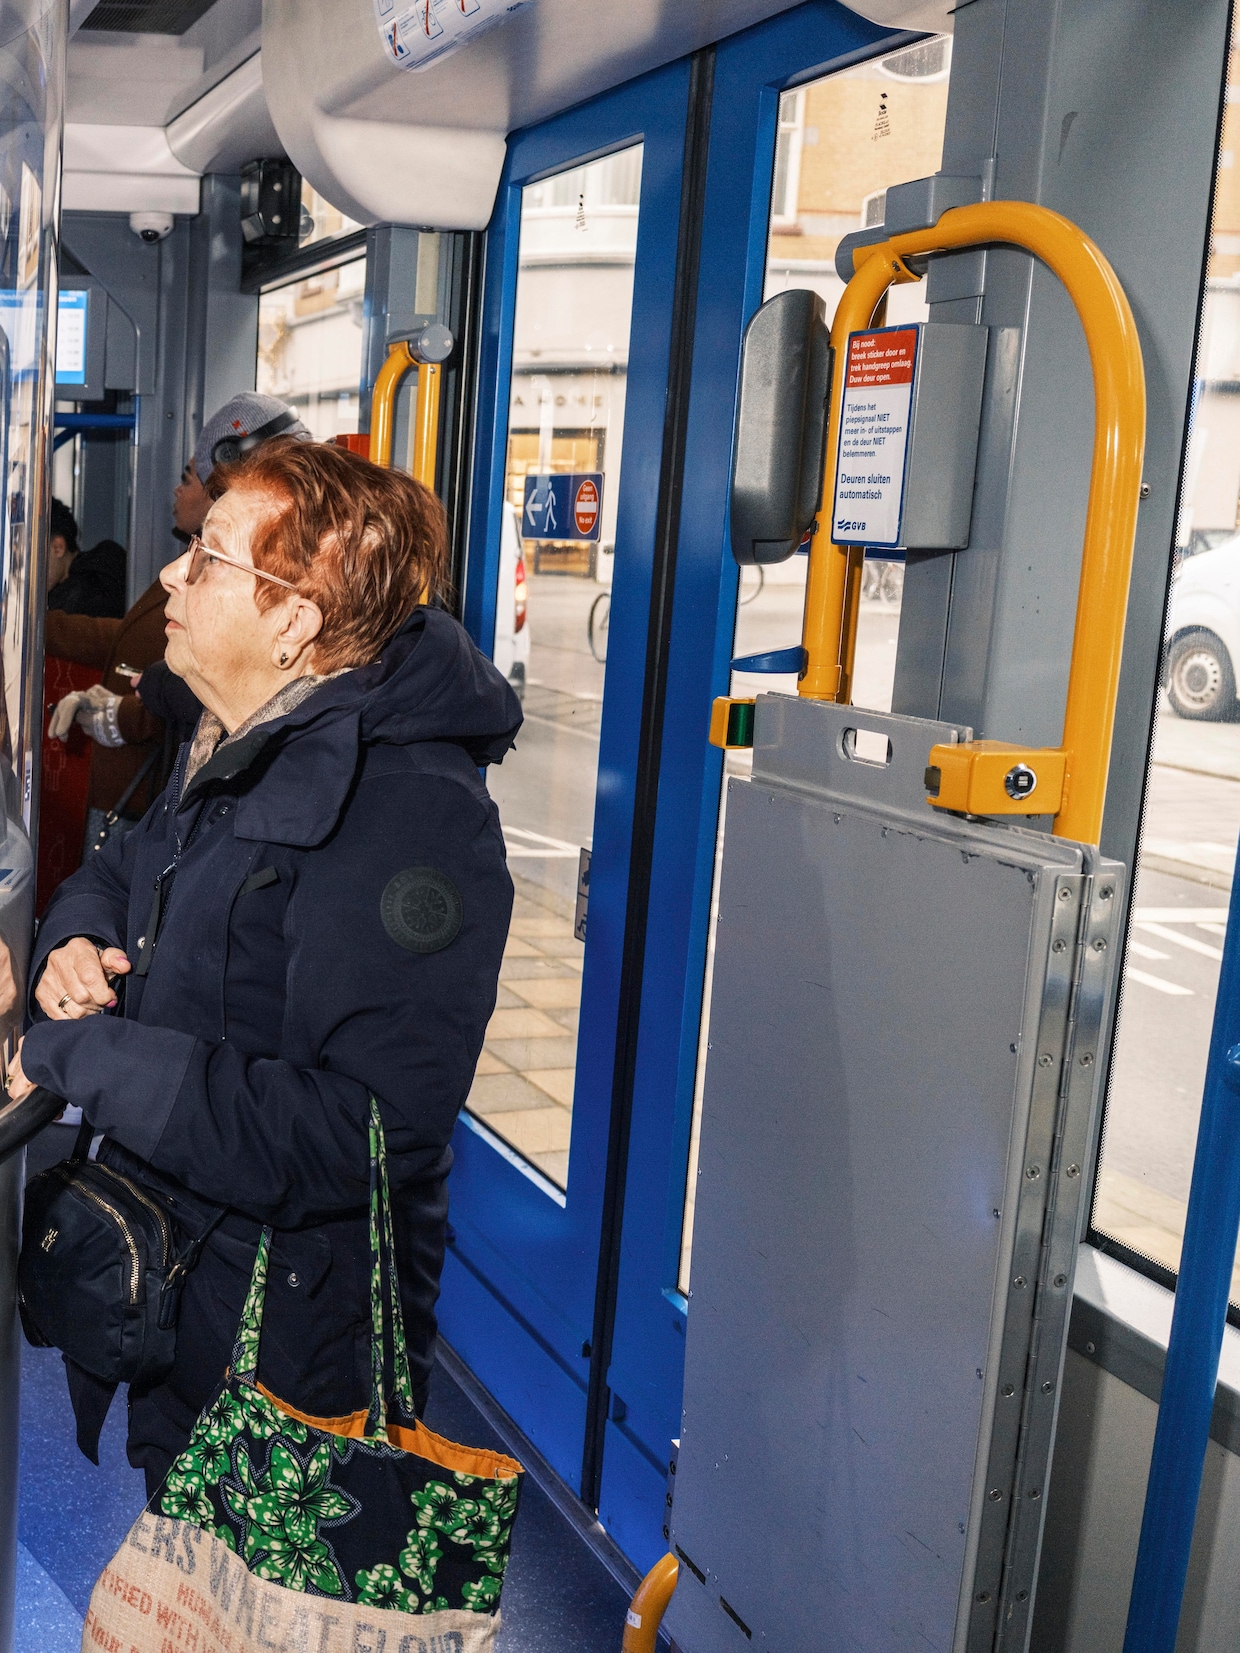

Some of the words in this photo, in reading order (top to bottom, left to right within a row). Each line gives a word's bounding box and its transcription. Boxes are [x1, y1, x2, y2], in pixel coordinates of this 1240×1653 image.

[852, 340, 860, 350] Bij
[860, 339, 876, 348] nood:
[851, 352, 866, 360] breek
[867, 350, 885, 359] sticker
[885, 348, 898, 357] door
[899, 348, 906, 356] en
[850, 363, 861, 372] trek
[862, 362, 890, 372] handgreep
[891, 359, 912, 369] omlaag.
[849, 375, 863, 384] Duw
[863, 374, 876, 383] deur
[876, 373, 891, 383] open.
[847, 404, 866, 413] Tijdens
[867, 403, 876, 411] het
[845, 414, 876, 425] piepsignaal
[877, 413, 890, 422] NIET
[868, 426, 874, 434] of
[874, 426, 902, 435] uitstappen
[852, 438, 859, 446] de
[860, 438, 872, 446] deur
[872, 437, 886, 446] NIET
[841, 473, 866, 484] Deuren
[867, 473, 891, 484] sluiten
[582, 484, 593, 492] Geen
[839, 489, 883, 500] automatisch
[578, 516, 585, 524] No
[585, 516, 593, 524] exit
[851, 521, 866, 530] GVB
